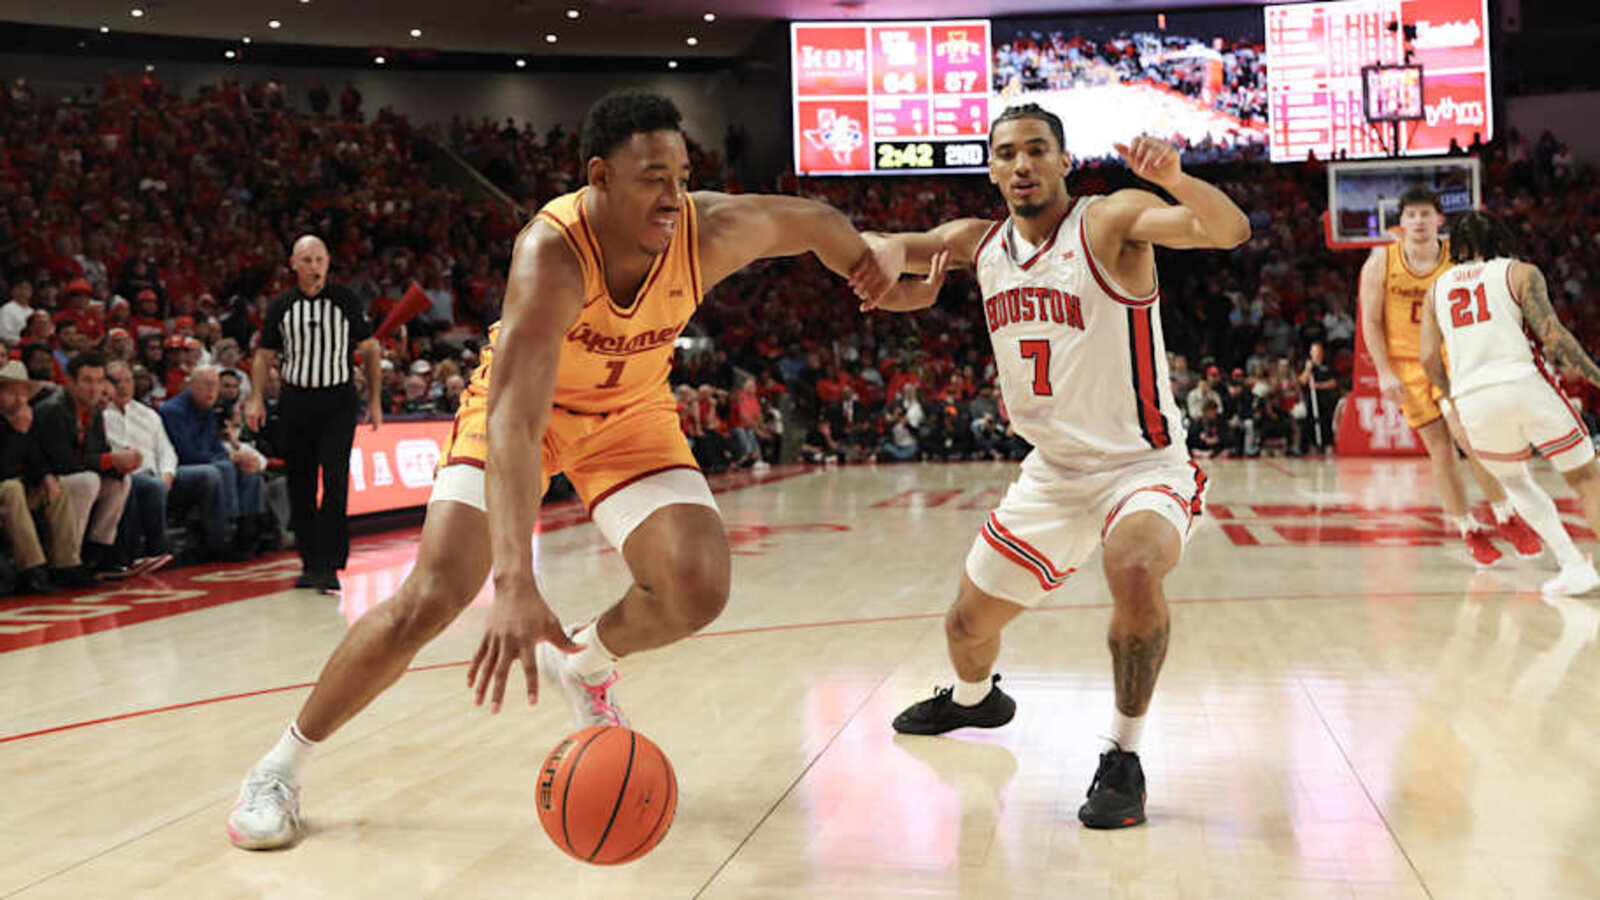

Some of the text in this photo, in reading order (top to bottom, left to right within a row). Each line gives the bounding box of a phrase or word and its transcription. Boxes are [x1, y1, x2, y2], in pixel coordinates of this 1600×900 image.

[1424, 96, 1484, 127] ythm
[877, 143, 934, 168] 2:42
[985, 287, 1086, 332] HOUSTON
[1447, 281, 1492, 328] 21
[595, 361, 627, 389] 1
[1019, 339, 1053, 396] 7
